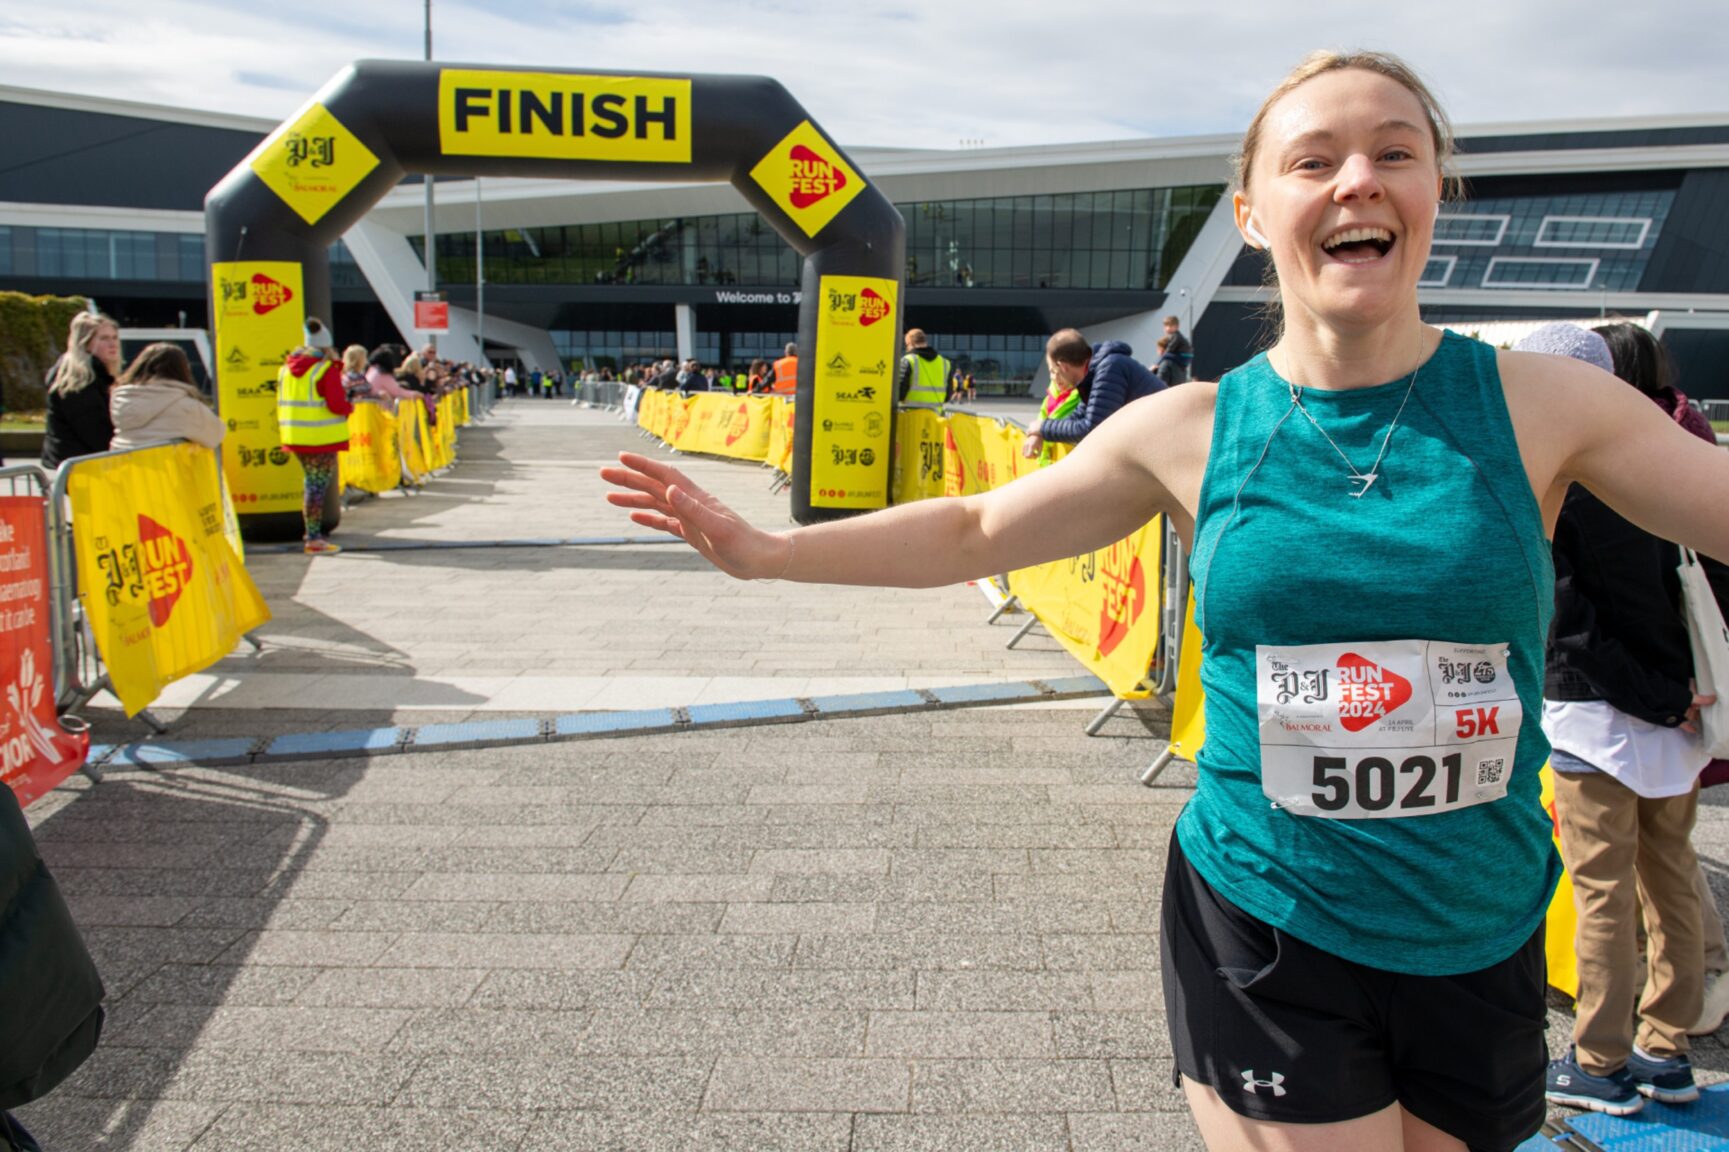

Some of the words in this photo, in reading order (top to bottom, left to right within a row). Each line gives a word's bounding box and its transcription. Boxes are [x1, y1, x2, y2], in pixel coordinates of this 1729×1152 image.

[454, 87, 677, 141] FINISH
[790, 160, 834, 179] RUN
[789, 178, 838, 195] FEST
[252, 283, 282, 296] RUN
[716, 291, 774, 303] Welcome
[777, 293, 791, 303] to
[252, 294, 285, 306] FEST
[861, 297, 885, 309] RUN
[861, 307, 887, 319] FEST
[836, 391, 859, 399] SEAA
[1100, 581, 1137, 627] FEST
[1271, 661, 1289, 671] The
[1338, 665, 1384, 684] RUN
[1438, 662, 1472, 685] P&J
[1271, 669, 1330, 705] P&J
[1338, 682, 1395, 701] FEST
[1339, 701, 1386, 718] 2024
[1284, 723, 1333, 732] BALMORAL
[1455, 706, 1500, 739] 5K
[1311, 752, 1462, 811] 5021
